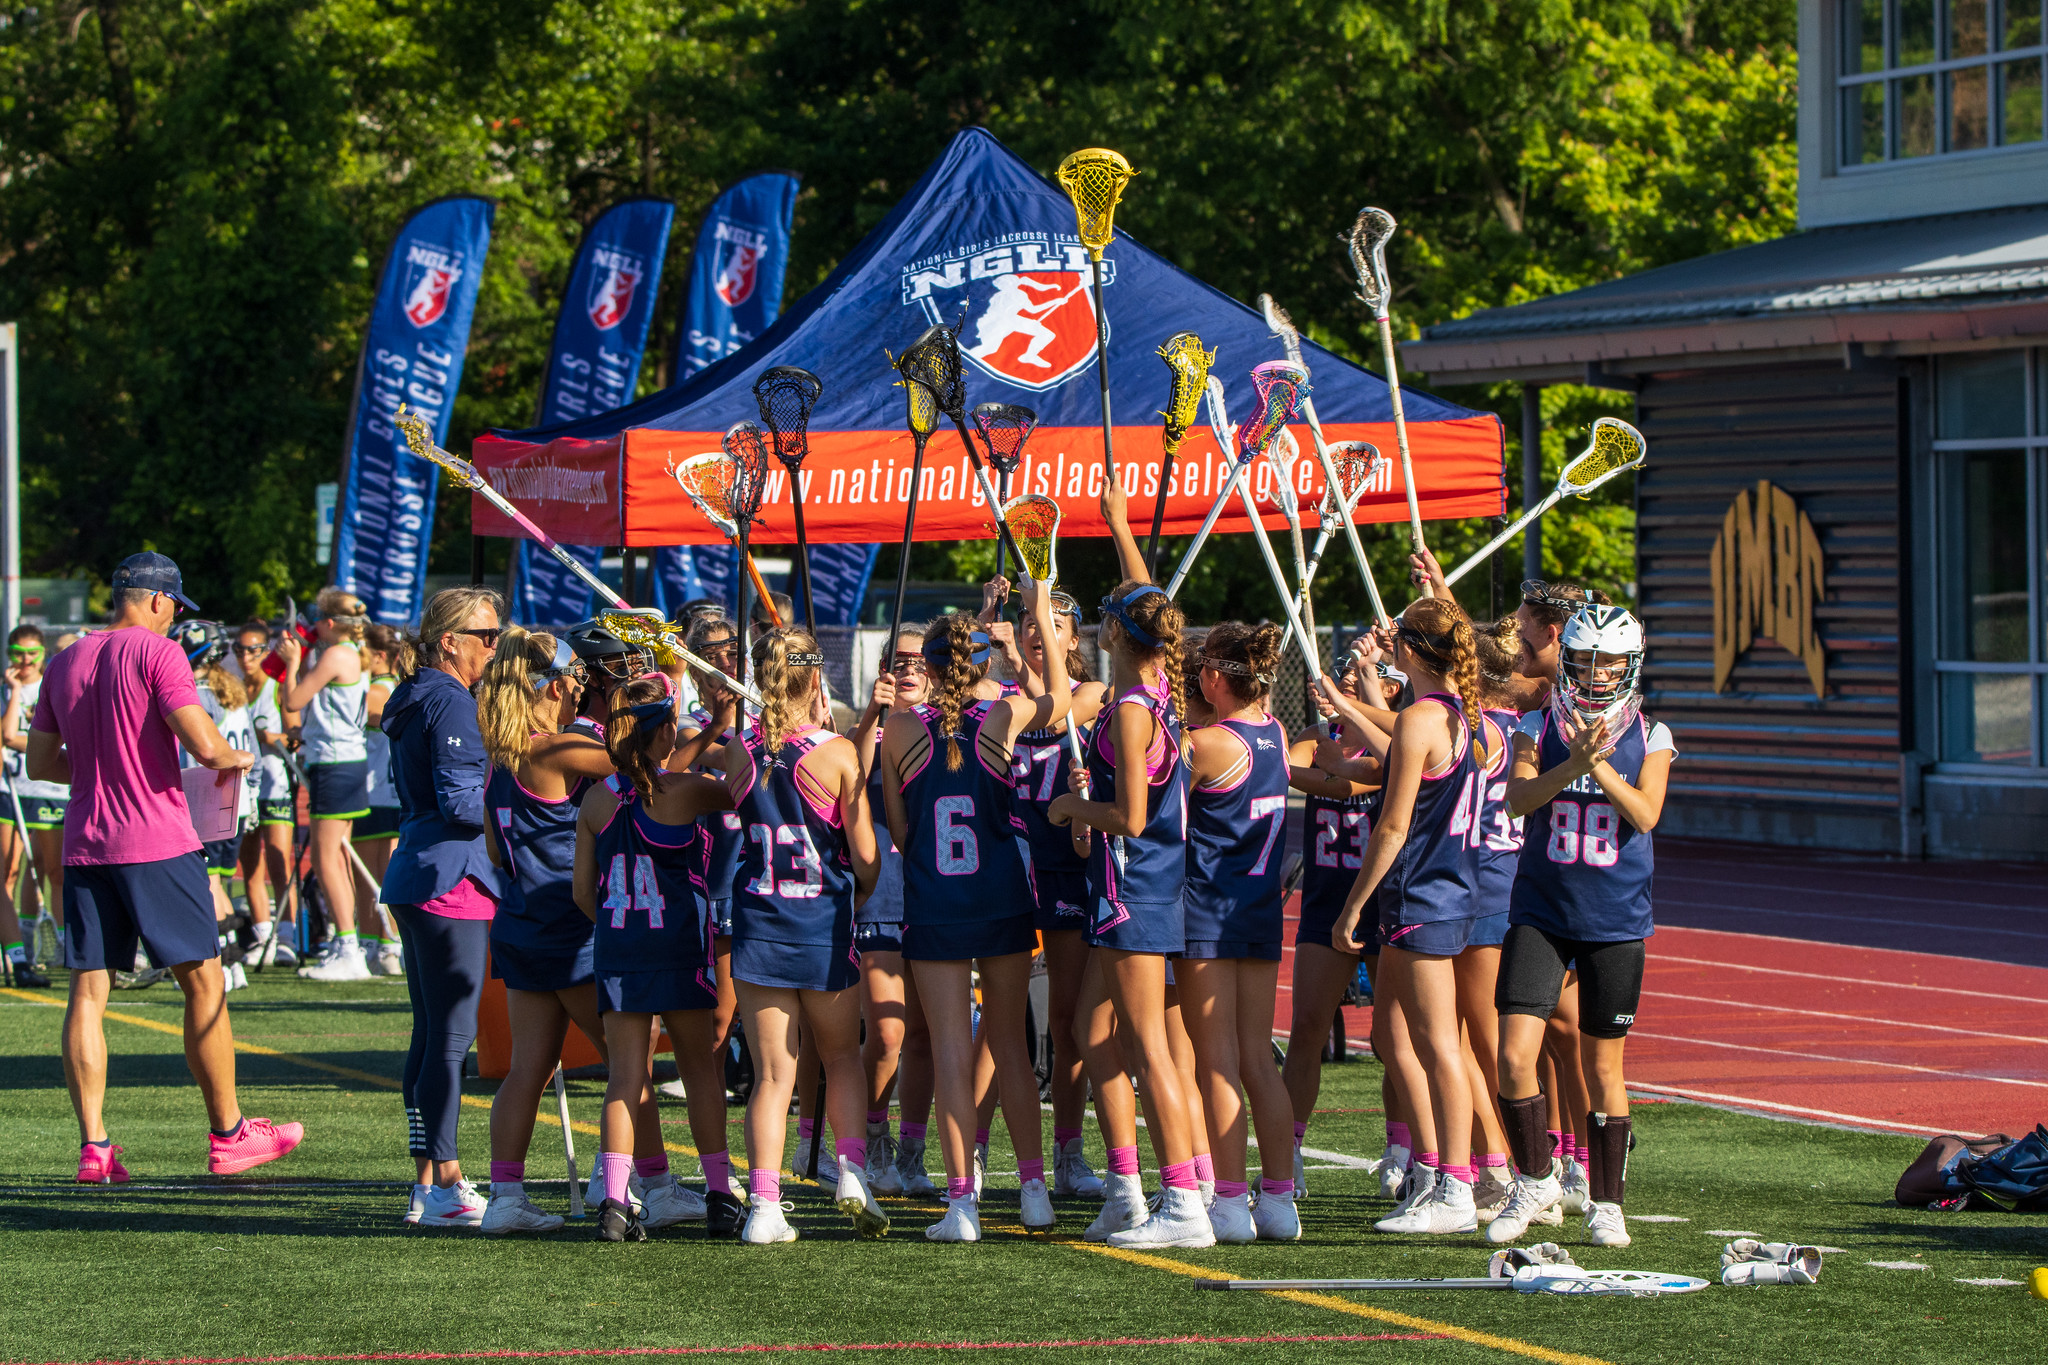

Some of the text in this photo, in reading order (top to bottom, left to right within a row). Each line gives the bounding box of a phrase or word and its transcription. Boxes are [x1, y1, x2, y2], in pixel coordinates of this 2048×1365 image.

[406, 246, 463, 277] NGLL
[592, 248, 643, 277] NGLL
[903, 249, 954, 273] NATIONAL
[995, 231, 1048, 245] LACROSSE
[908, 243, 1109, 300] NGLL
[367, 348, 408, 442] GIRLS
[376, 470, 426, 620] LACROSSE
[1710, 480, 1826, 699] UMBC
[1011, 743, 1062, 802] 27
[934, 795, 980, 876] 6
[1248, 794, 1287, 876] 7
[1316, 808, 1372, 869] 23
[1547, 800, 1622, 867] 88
[602, 853, 666, 929] 44
[1612, 1014, 1636, 1025] STX
